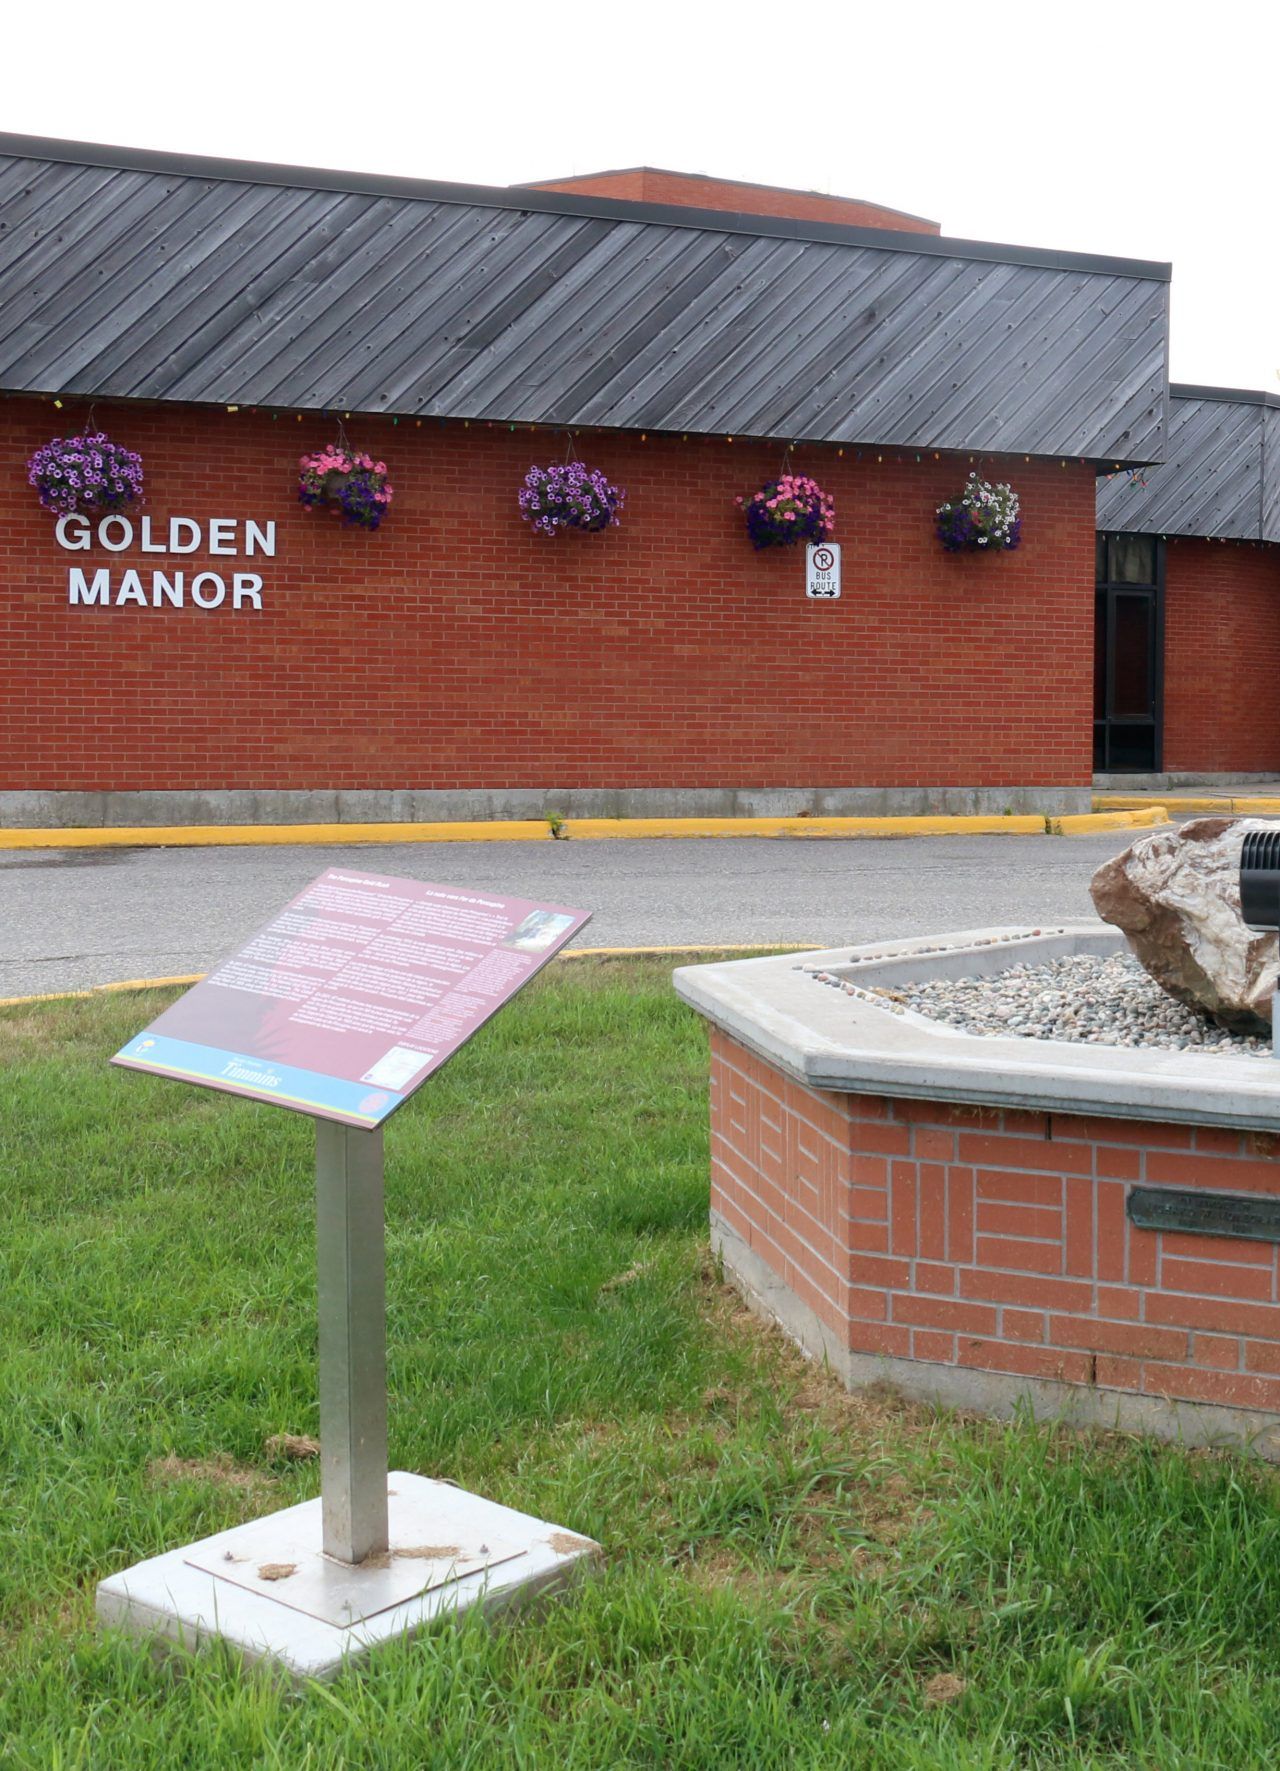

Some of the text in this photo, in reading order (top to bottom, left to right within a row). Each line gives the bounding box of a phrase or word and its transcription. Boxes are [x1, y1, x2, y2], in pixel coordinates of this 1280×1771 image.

[55, 513, 276, 557] GOLDEN
[69, 567, 264, 610] MANOR
[810, 581, 837, 591] ROUTE
[815, 571, 832, 580] BUS
[221, 1061, 282, 1087] Timmins
